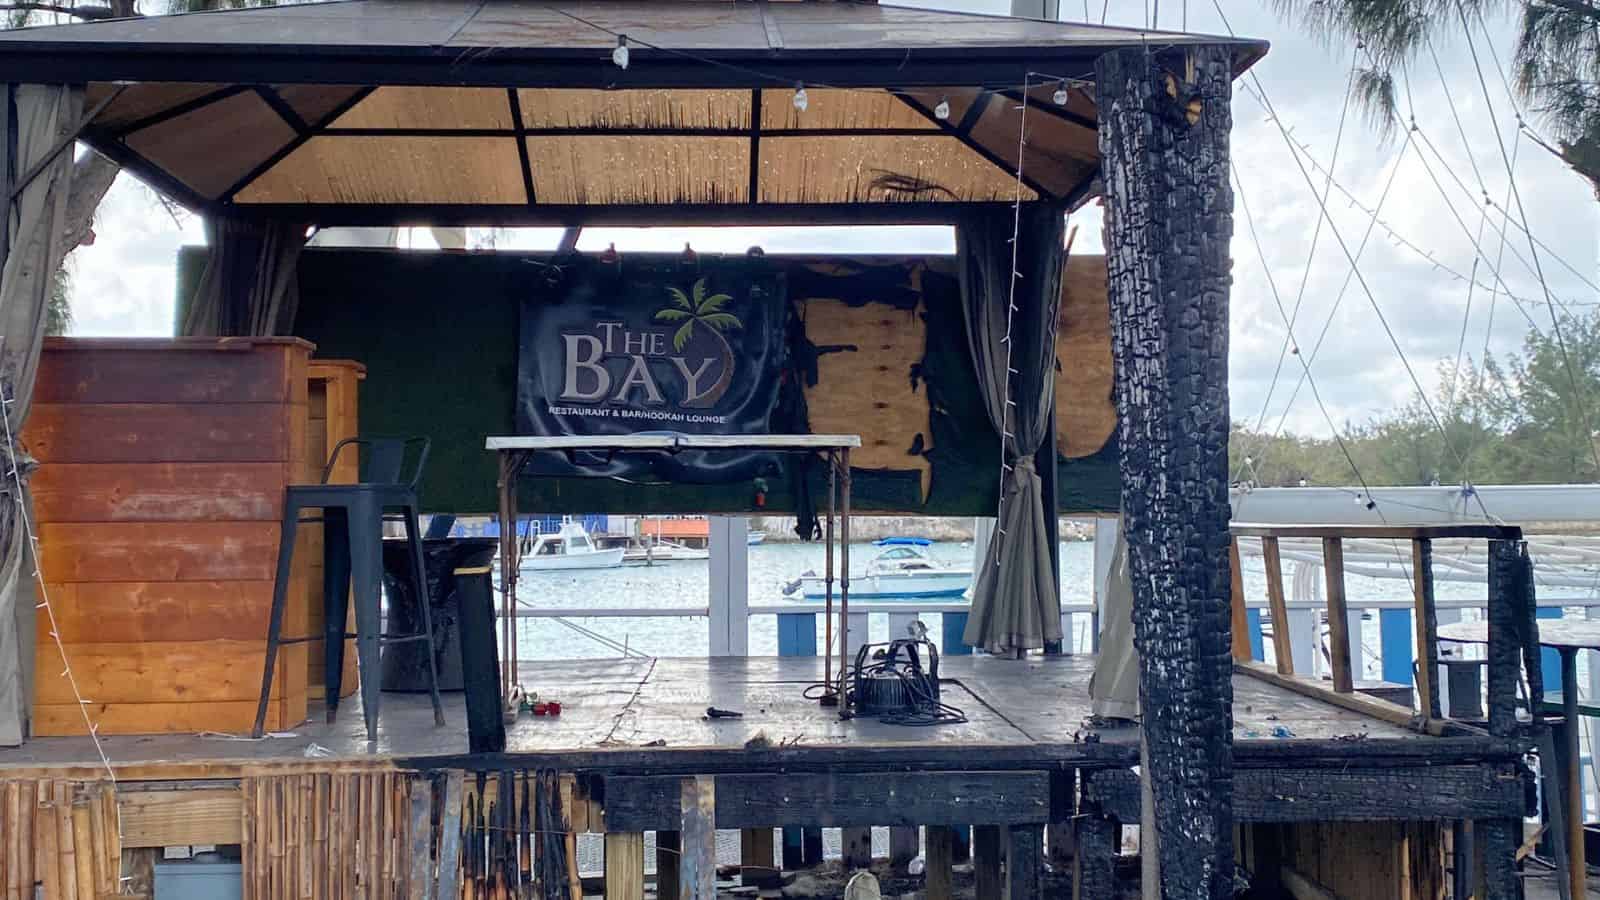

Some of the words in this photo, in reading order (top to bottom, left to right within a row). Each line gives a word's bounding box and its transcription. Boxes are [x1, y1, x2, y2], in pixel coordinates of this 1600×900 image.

[597, 322, 665, 355] THE
[560, 334, 717, 405] BAY
[548, 406, 611, 417] RESTAURANT
[612, 409, 620, 417] &
[621, 409, 685, 422] BAR/HOOKAH
[686, 414, 727, 424] LOUNGE
